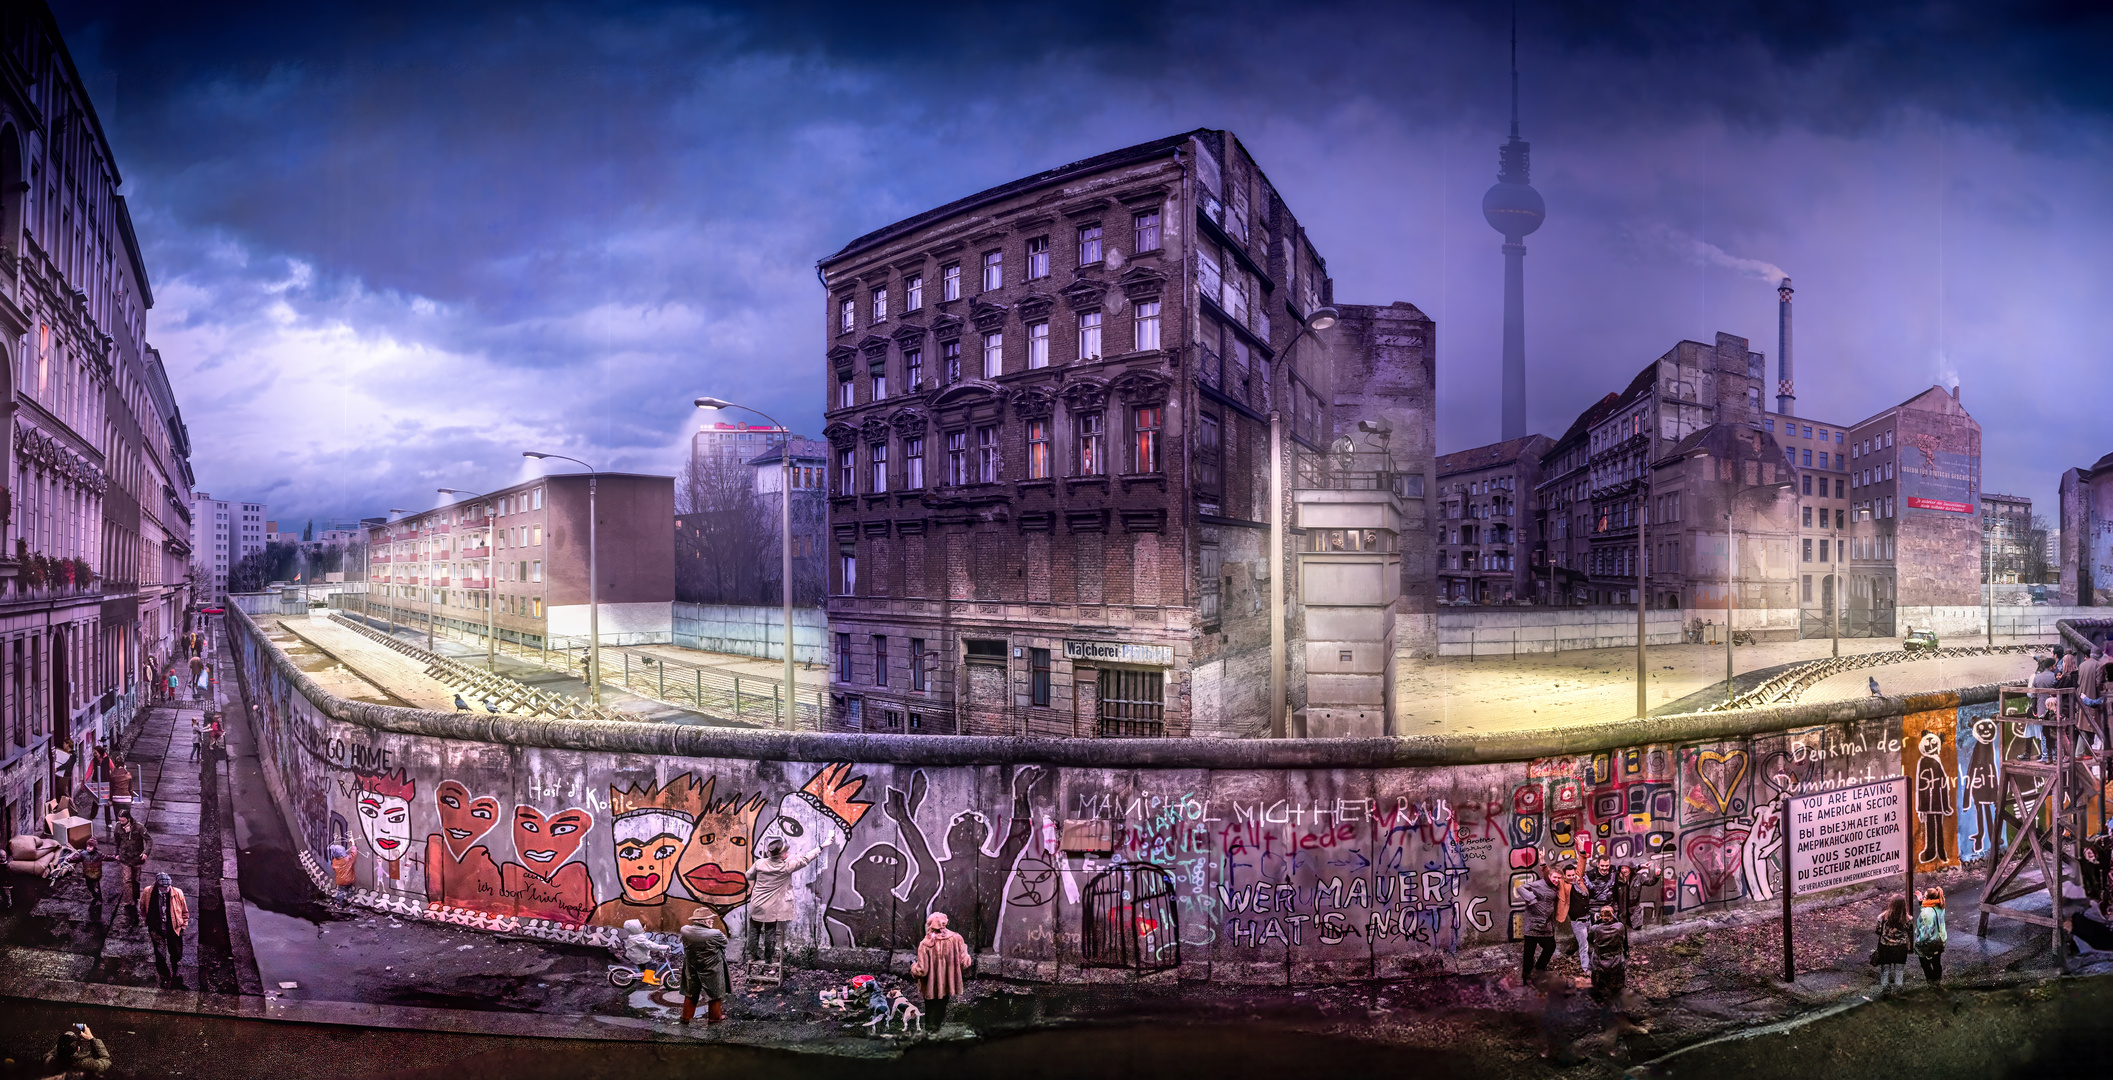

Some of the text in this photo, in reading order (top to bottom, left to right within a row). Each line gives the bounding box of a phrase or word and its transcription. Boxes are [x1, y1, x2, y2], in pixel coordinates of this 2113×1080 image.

[326, 738, 392, 770] GO HOME
[1791, 730, 1909, 762] Denkmal der
[337, 779, 385, 804] RAUS
[1773, 766, 1875, 793] Dummheit
[1918, 764, 1995, 792] Sturheit
[1797, 795, 1898, 824] THE AMERICAN SECTOR
[1802, 783, 1893, 809] YOU ARE LEAVING
[1162, 795, 1221, 823] HOL
[1233, 799, 1304, 828] MICH
[1799, 811, 1897, 839] ВЫ ВЫЕЗЖАЕТЕ ИЗ
[1797, 823, 1900, 853] АМЕРИКАНСКОГО СЕКТОРА
[1811, 842, 1882, 865] VOUS SORTEZ
[1798, 869, 1810, 881] DU
[1813, 861, 1851, 878] SECTEUR
[1833, 877, 1842, 886] DEN
[1843, 869, 1881, 883] AMERIKANISCHEN
[1217, 867, 1470, 915] WER MAUERT
[1368, 895, 1494, 945] NÖTIG
